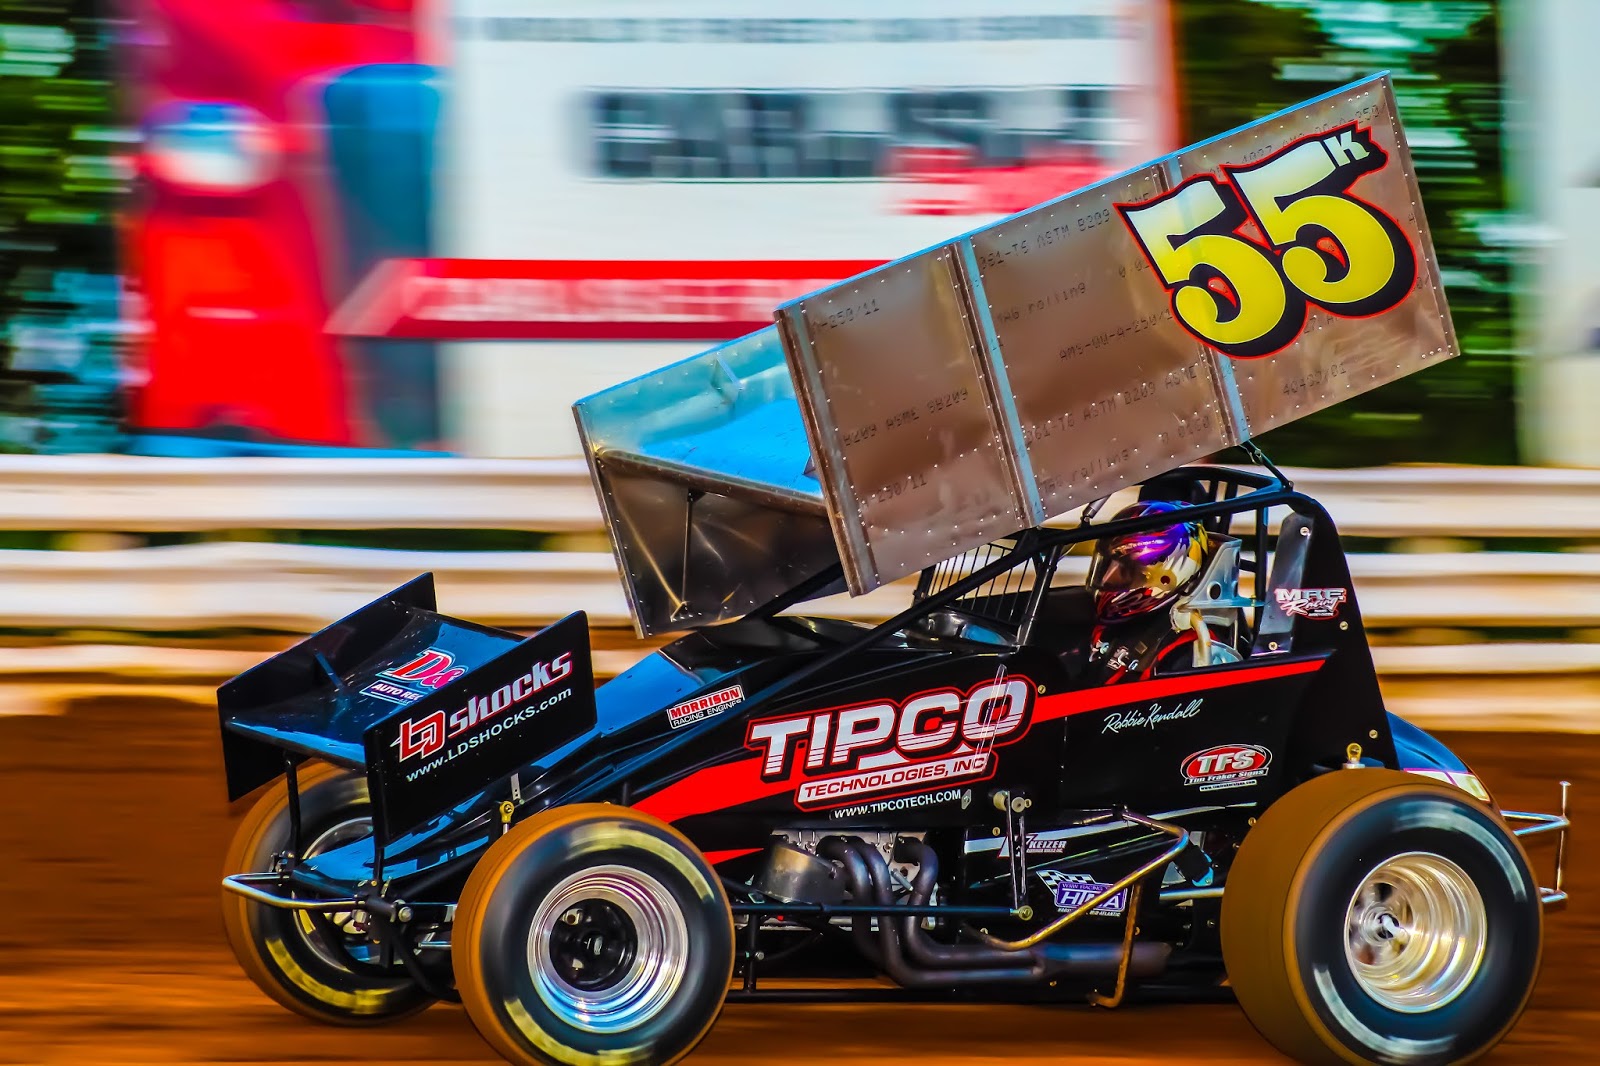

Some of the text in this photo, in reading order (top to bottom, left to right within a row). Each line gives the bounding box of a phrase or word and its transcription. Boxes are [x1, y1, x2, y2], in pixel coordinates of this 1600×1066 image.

[1036, 223, 1071, 250] ASTM
[812, 297, 881, 333] -250/11
[1083, 400, 1117, 420] ASTM
[371, 682, 401, 696] AUTO
[447, 651, 574, 739] shocks
[670, 688, 740, 719] MORRISON
[673, 711, 704, 727] RACING
[751, 679, 1028, 776] TIPCO
[1143, 698, 1204, 730] Kendall
[406, 687, 572, 783] www.LDSHOCKS.com
[1196, 749, 1257, 774] TFS
[804, 763, 950, 798] TECHNOLOGIES,
[833, 789, 962, 820] WWW.TIPCOTECH.COM
[1029, 840, 1067, 849] KEIZER
